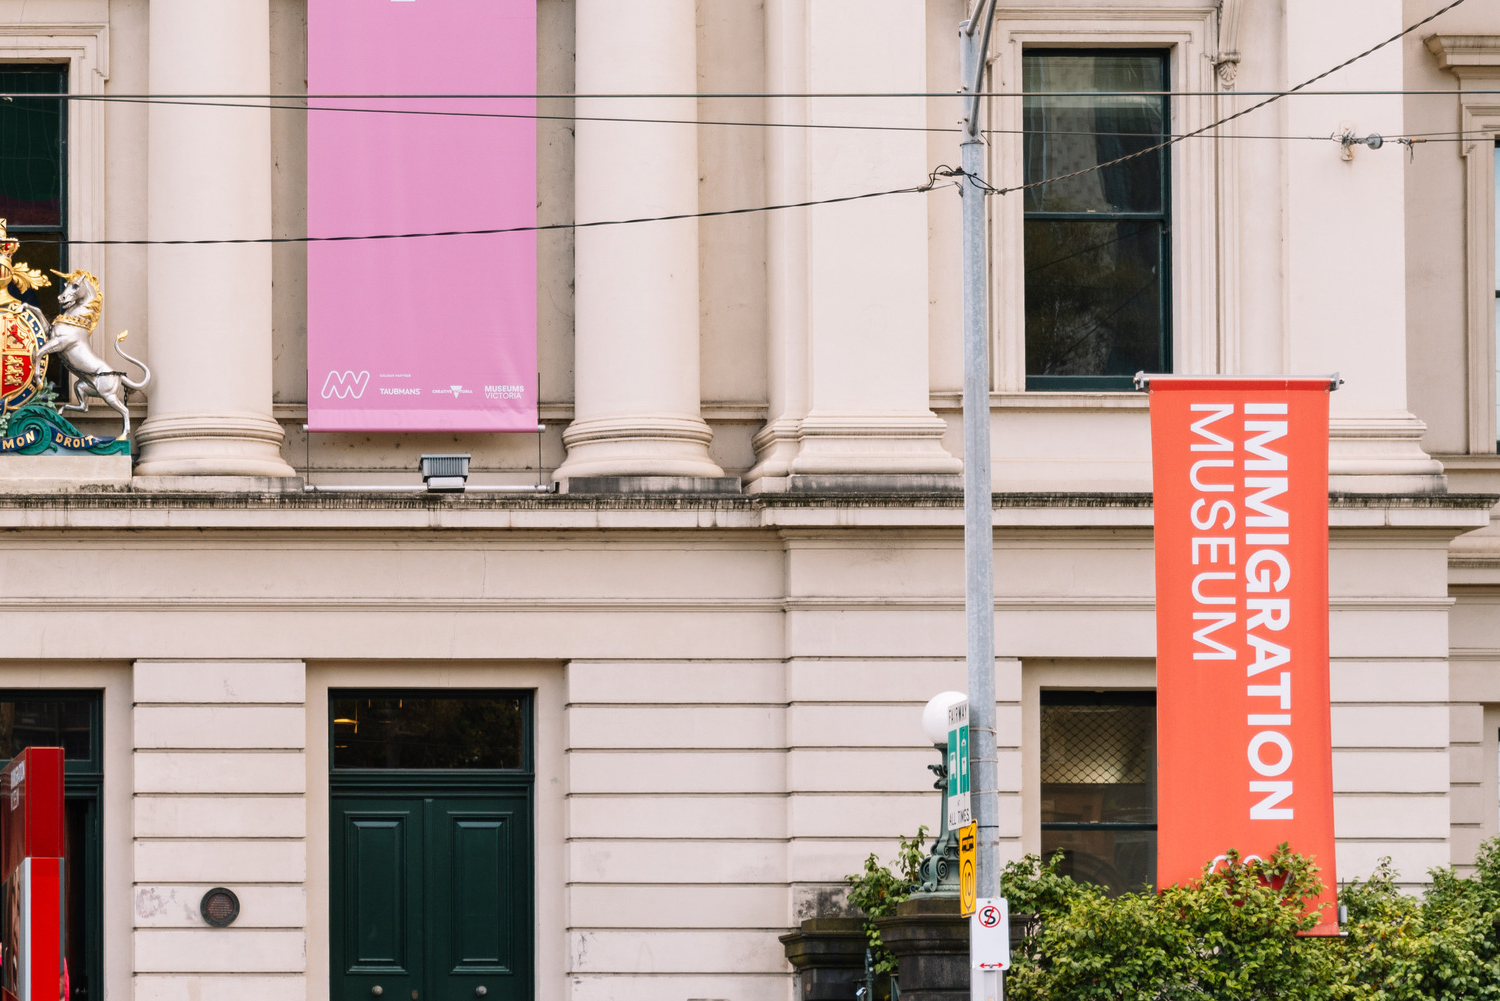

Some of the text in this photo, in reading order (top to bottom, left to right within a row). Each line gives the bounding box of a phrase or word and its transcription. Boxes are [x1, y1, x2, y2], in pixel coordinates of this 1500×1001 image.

[485, 392, 522, 400] VICTORIA
[3, 430, 35, 450] MON
[55, 433, 93, 448] DROIT
[1190, 404, 1237, 661] MUSEUM
[1243, 403, 1294, 821] IMMIGRATION
[948, 704, 968, 726] FAIRWAY
